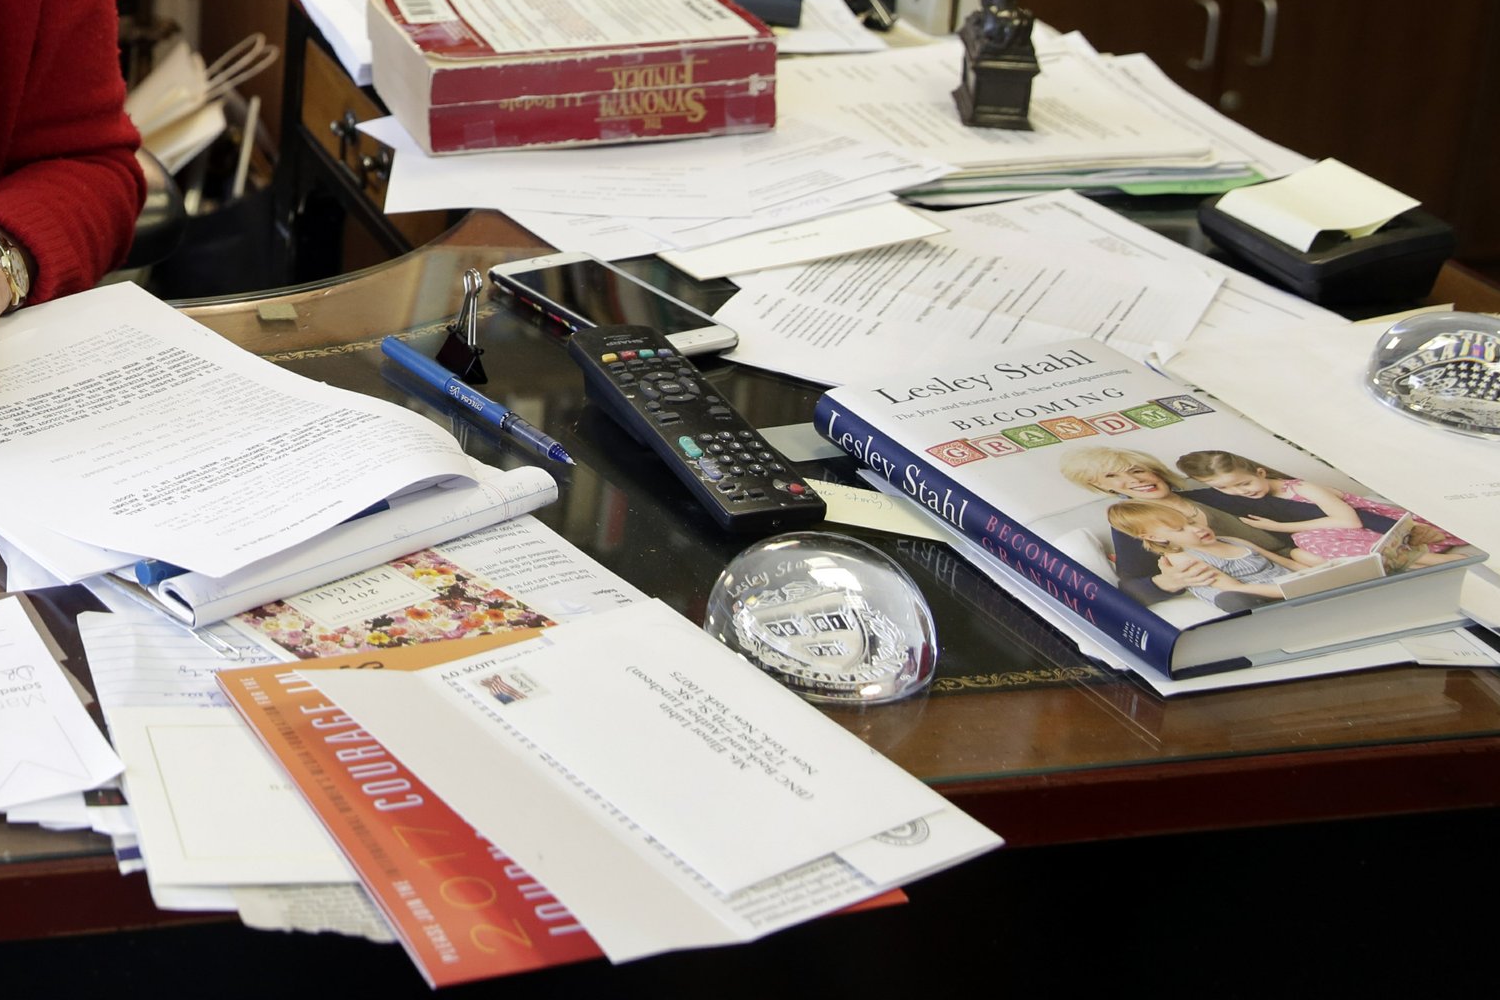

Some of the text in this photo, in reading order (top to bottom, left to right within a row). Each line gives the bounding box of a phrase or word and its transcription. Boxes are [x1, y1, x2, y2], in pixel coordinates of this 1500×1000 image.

[612, 54, 696, 91] FINDER
[601, 88, 708, 123] SYNONYM
[606, 339, 644, 347] SHARP
[872, 349, 1097, 404] Lesley Stahl
[892, 366, 1132, 422] The Joys and Science of the New Grandparenting
[950, 386, 1125, 431] BECOMING
[946, 397, 1202, 461] GRANDMA
[827, 409, 969, 531] Lesley Stahl
[985, 515, 1099, 602] BECOMING
[298, 572, 391, 604] FALL GALA
[726, 569, 770, 600] Lesley
[980, 535, 1098, 625] GRANDMA
[336, 587, 379, 605] 2017
[461, 659, 496, 673] SCOTT
[239, 677, 260, 690] THE
[250, 691, 270, 704] FOR
[275, 671, 317, 694] IN
[669, 671, 704, 695] 10075
[677, 687, 694, 700] 8K
[703, 694, 729, 715] York
[262, 706, 302, 749] FOUNDATION
[625, 665, 814, 799] (BNC Book and Author Luncheon)
[658, 702, 750, 770] Ms. Elinor Lubin
[711, 713, 737, 733] 77th
[731, 714, 758, 734] New
[300, 702, 423, 812] COURAGE
[736, 732, 764, 751] East
[301, 752, 325, 775] MEDIA
[763, 750, 785, 766] 176
[792, 755, 817, 775] New
[318, 779, 352, 812] WOMEN'S
[392, 825, 532, 955] 2017
[393, 880, 417, 897] THE
[406, 898, 434, 922] JOIN
[422, 923, 459, 963] PLEASE
